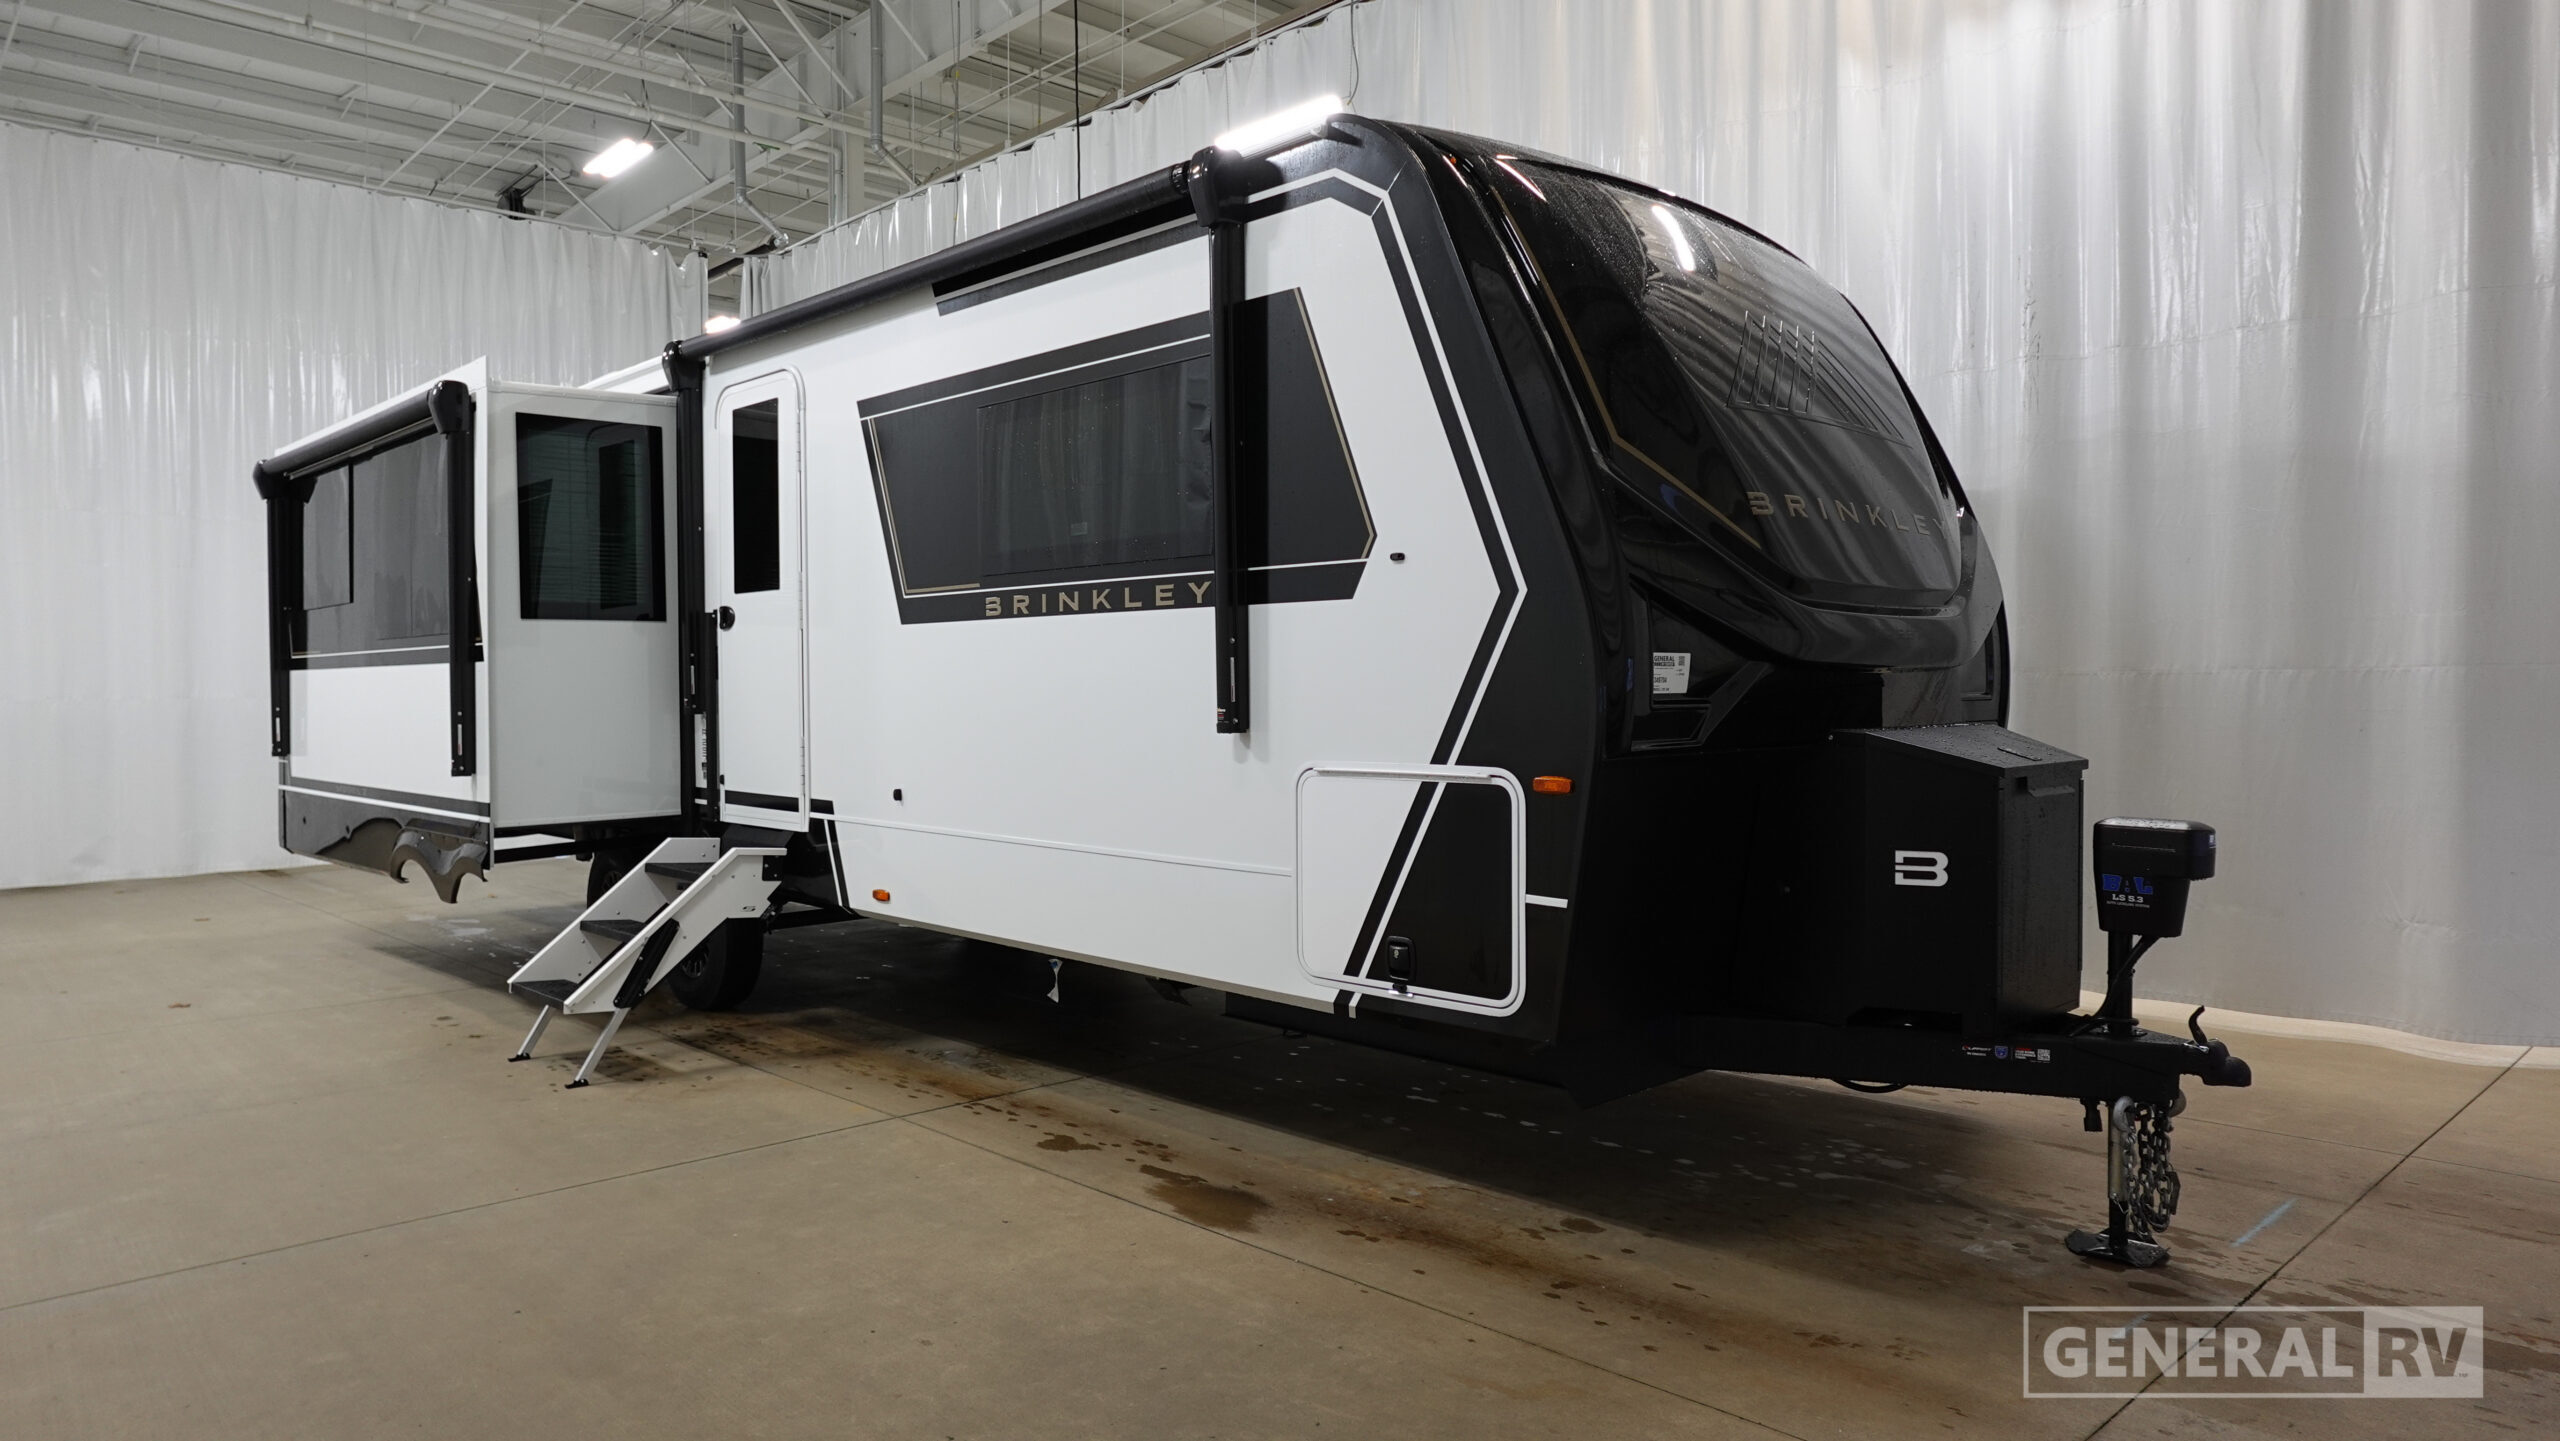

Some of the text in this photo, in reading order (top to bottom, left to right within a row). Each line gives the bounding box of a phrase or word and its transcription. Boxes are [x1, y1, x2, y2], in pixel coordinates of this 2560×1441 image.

[1746, 491, 1948, 539] BRINKLEY
[985, 581, 1212, 617] BRINKLEY
[1894, 849, 1949, 887] B
[2102, 873, 2153, 895] BL
[2112, 893, 2126, 902] LS
[2127, 895, 2144, 904] 5.3
